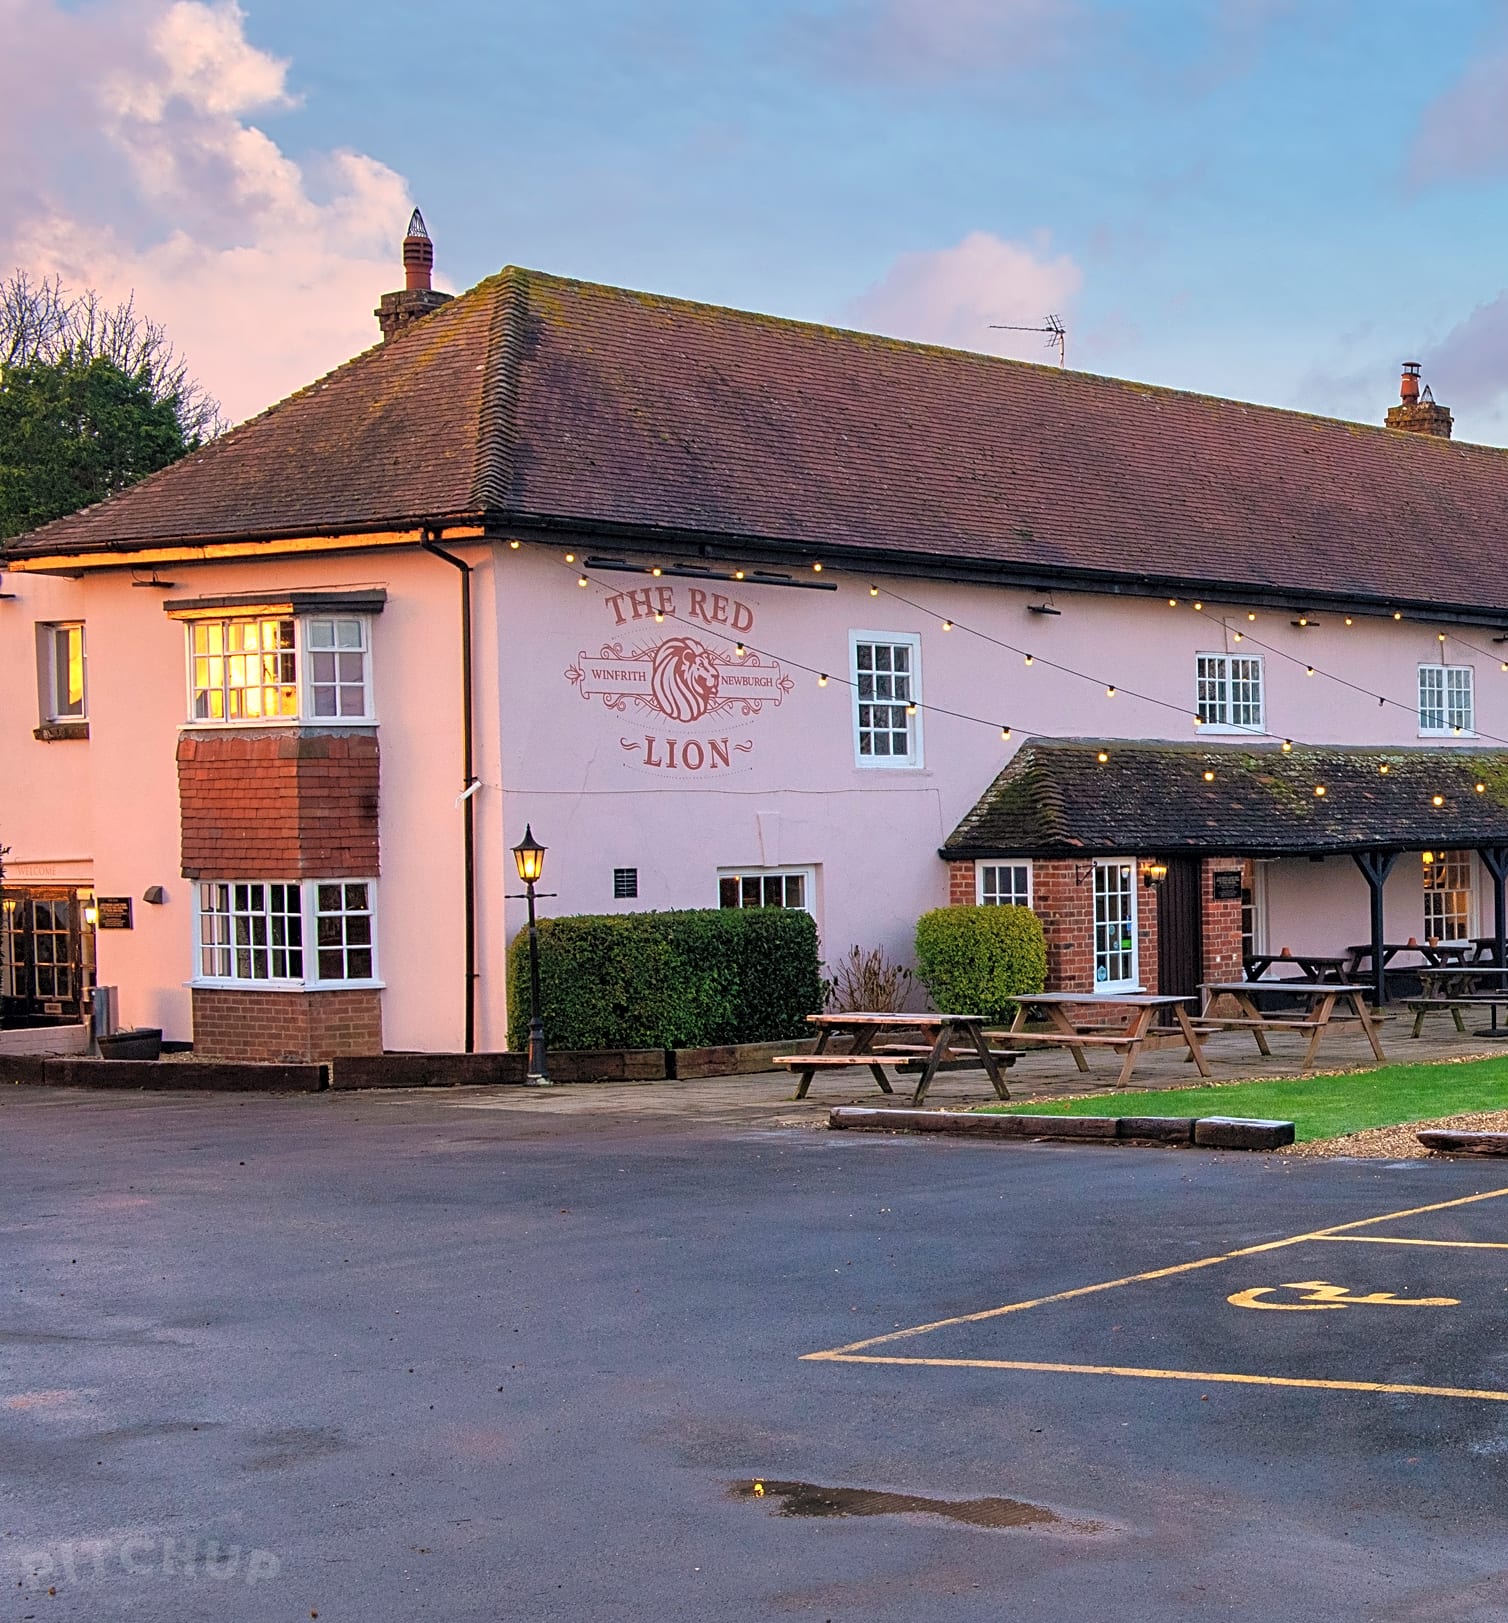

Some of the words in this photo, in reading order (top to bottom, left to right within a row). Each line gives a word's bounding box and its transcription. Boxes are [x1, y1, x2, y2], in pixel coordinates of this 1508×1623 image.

[605, 586, 676, 626] THE
[687, 587, 754, 634] RED
[591, 668, 647, 682] WINFRITH
[721, 675, 773, 687] NEWBURGH
[642, 734, 731, 771] LION
[17, 866, 57, 877] WELCOME
